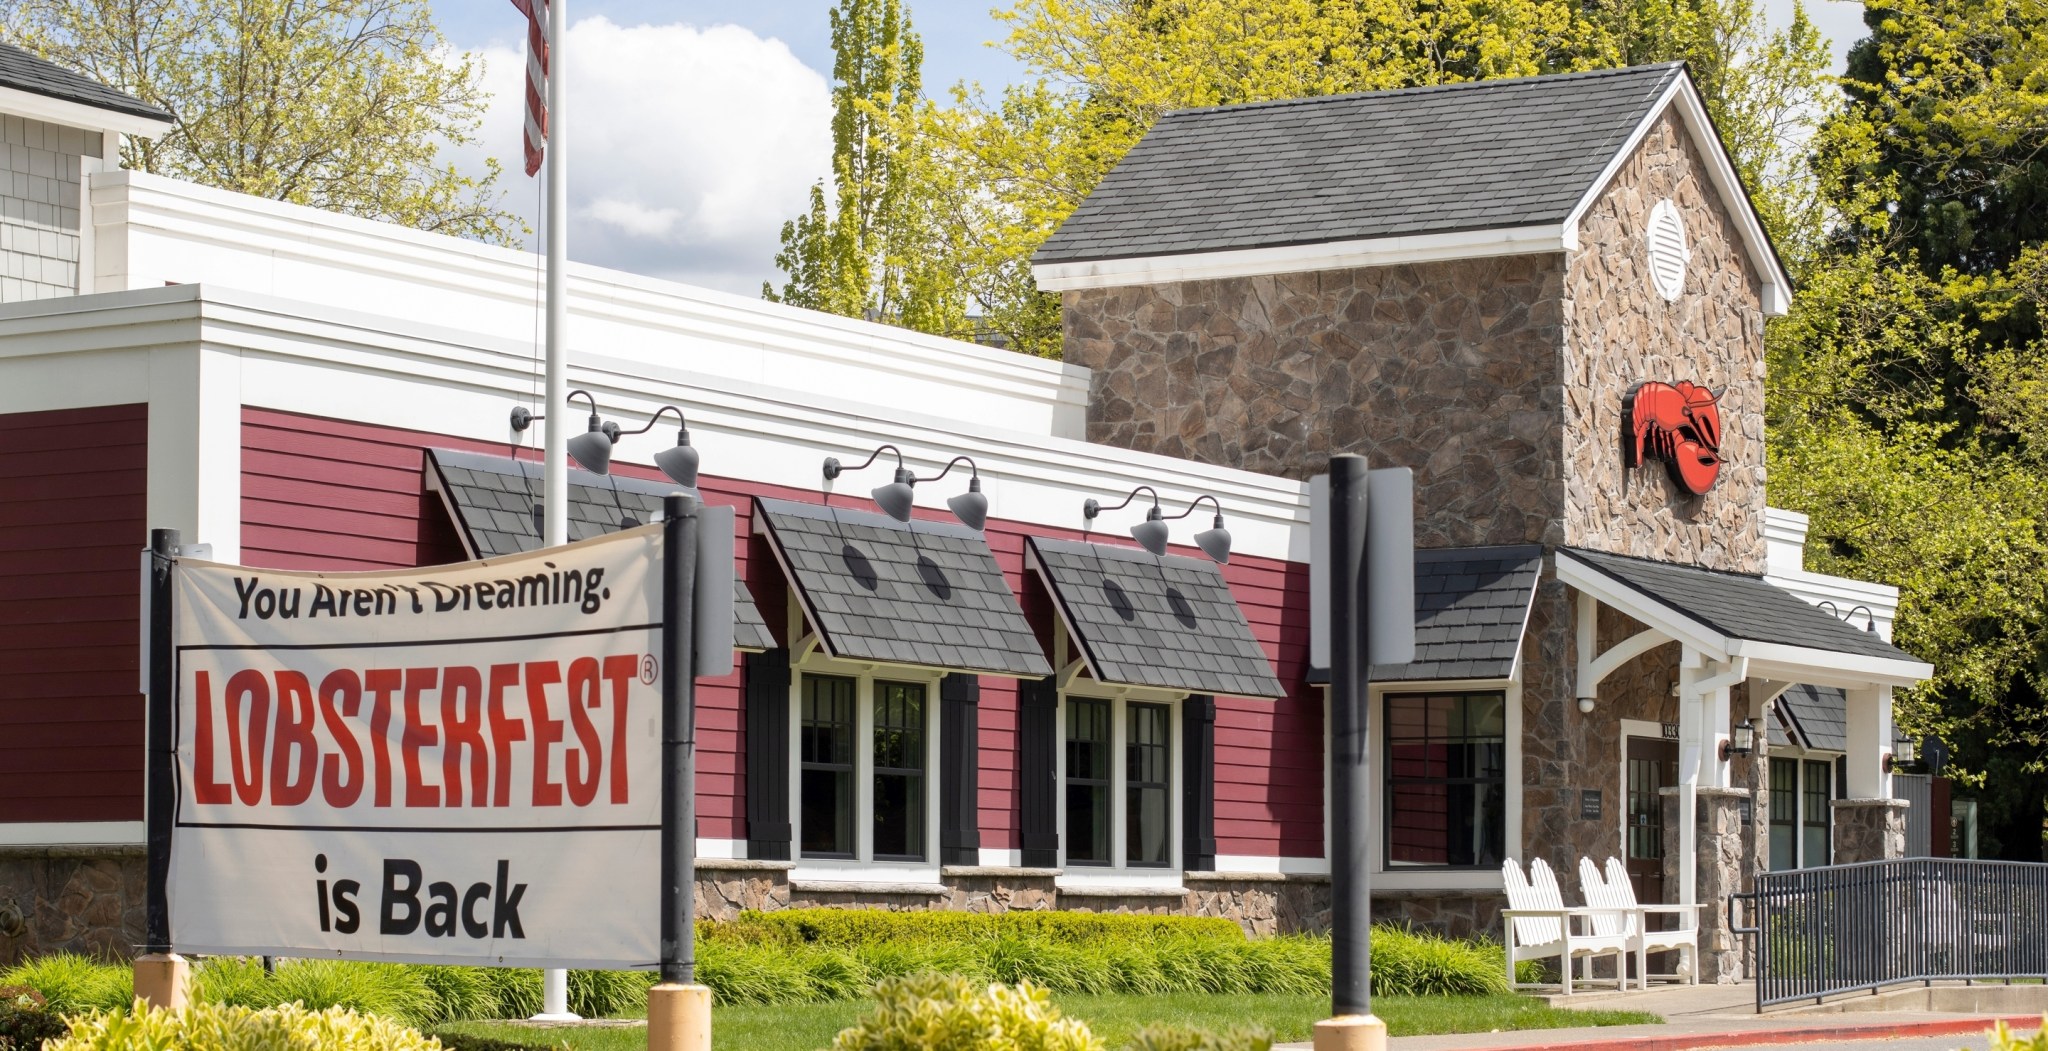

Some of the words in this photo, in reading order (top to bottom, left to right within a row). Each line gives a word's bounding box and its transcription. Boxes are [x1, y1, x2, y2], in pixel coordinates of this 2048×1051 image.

[234, 577, 301, 620] You
[309, 583, 424, 618] Aren't
[417, 561, 610, 615] Dreaming.
[314, 853, 361, 935] is
[379, 858, 528, 940] Back
